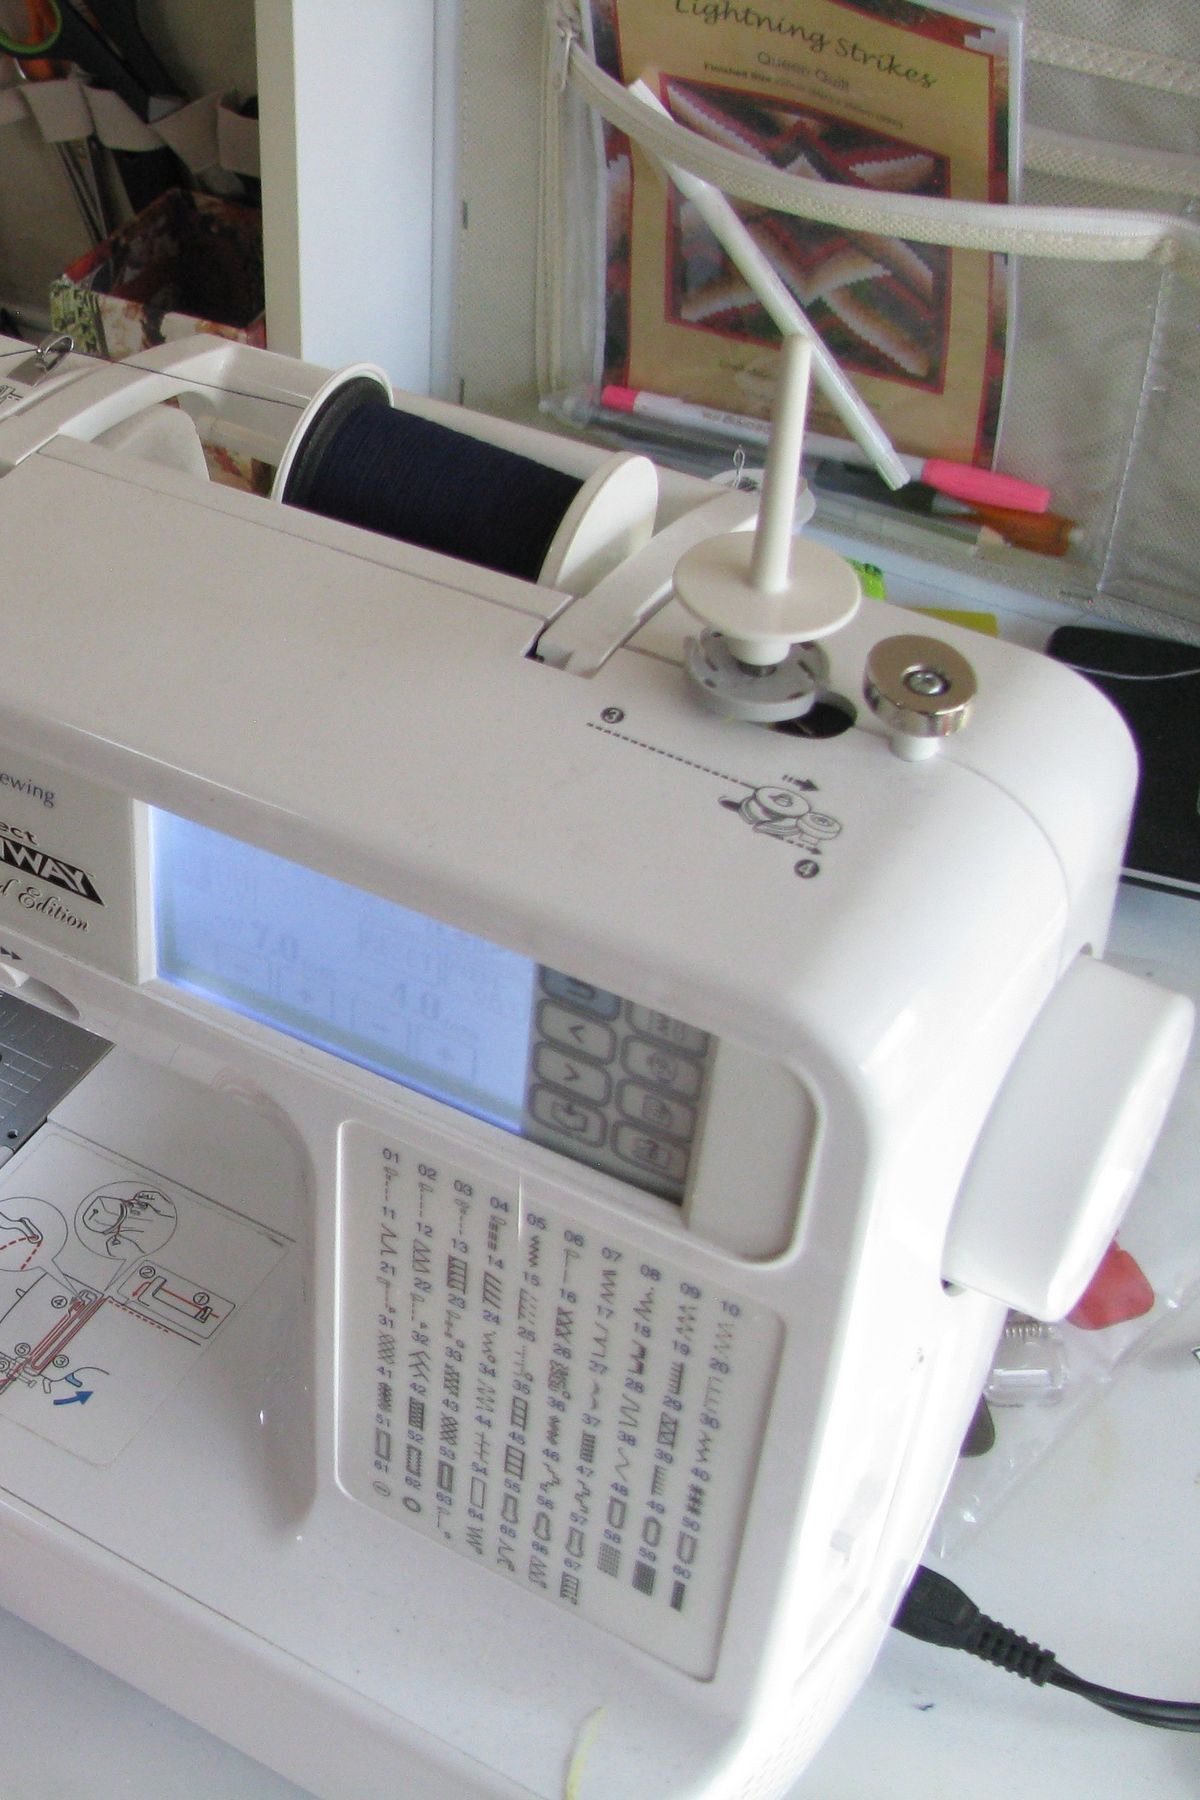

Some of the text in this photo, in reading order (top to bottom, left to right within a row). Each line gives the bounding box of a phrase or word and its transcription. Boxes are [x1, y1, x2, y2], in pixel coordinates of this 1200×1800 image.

[837, 38, 936, 88] Strikes
[18, 886, 90, 932] Edition
[382, 1148, 398, 1163] 01
[418, 1163, 437, 1181] 02
[454, 1180, 472, 1196] 03
[490, 1197, 508, 1212] 04
[527, 1213, 547, 1230] 05
[602, 1247, 622, 1262] 07
[640, 1264, 661, 1281] 08
[721, 1301, 741, 1318] 10
[382, 1206, 395, 1220] 11
[417, 1222, 432, 1238] 12
[452, 1239, 468, 1253] 13
[488, 1255, 503, 1269] 14
[523, 1271, 540, 1286] 15
[597, 1305, 614, 1319] 17
[673, 1340, 691, 1356] 19
[709, 1357, 730, 1374] 20
[379, 1314, 393, 1328] 31
[411, 1330, 429, 1346] 32
[479, 1363, 496, 1378] 34
[512, 1379, 530, 1395] 35
[582, 1412, 601, 1427] 37
[618, 1430, 636, 1447] 38
[655, 1448, 674, 1464] 39
[691, 1467, 711, 1482] 40
[380, 1261, 395, 1276] 21
[414, 1277, 432, 1292] 22
[483, 1310, 500, 1325] 24
[517, 1326, 536, 1342] 25
[625, 1377, 644, 1393] 28
[663, 1395, 682, 1411] 29
[374, 1460, 388, 1473] 61
[405, 1475, 421, 1489] 62
[468, 1507, 484, 1521] 64
[564, 1557, 582, 1571] 67
[376, 1414, 390, 1428] 51
[408, 1430, 424, 1445] 52
[472, 1462, 488, 1476] 54
[504, 1478, 521, 1493] 55
[536, 1495, 554, 1510] 56
[570, 1512, 588, 1525] 57
[603, 1528, 622, 1544] 58
[639, 1547, 657, 1562] 59
[377, 1366, 392, 1378] 41
[410, 1382, 426, 1395] 42
[475, 1415, 492, 1428] 44
[508, 1431, 526, 1446] 45
[542, 1449, 560, 1462] 46
[576, 1465, 594, 1478] 47
[610, 1482, 628, 1496] 48
[646, 1500, 665, 1514] 49
[682, 1516, 701, 1532] 50
